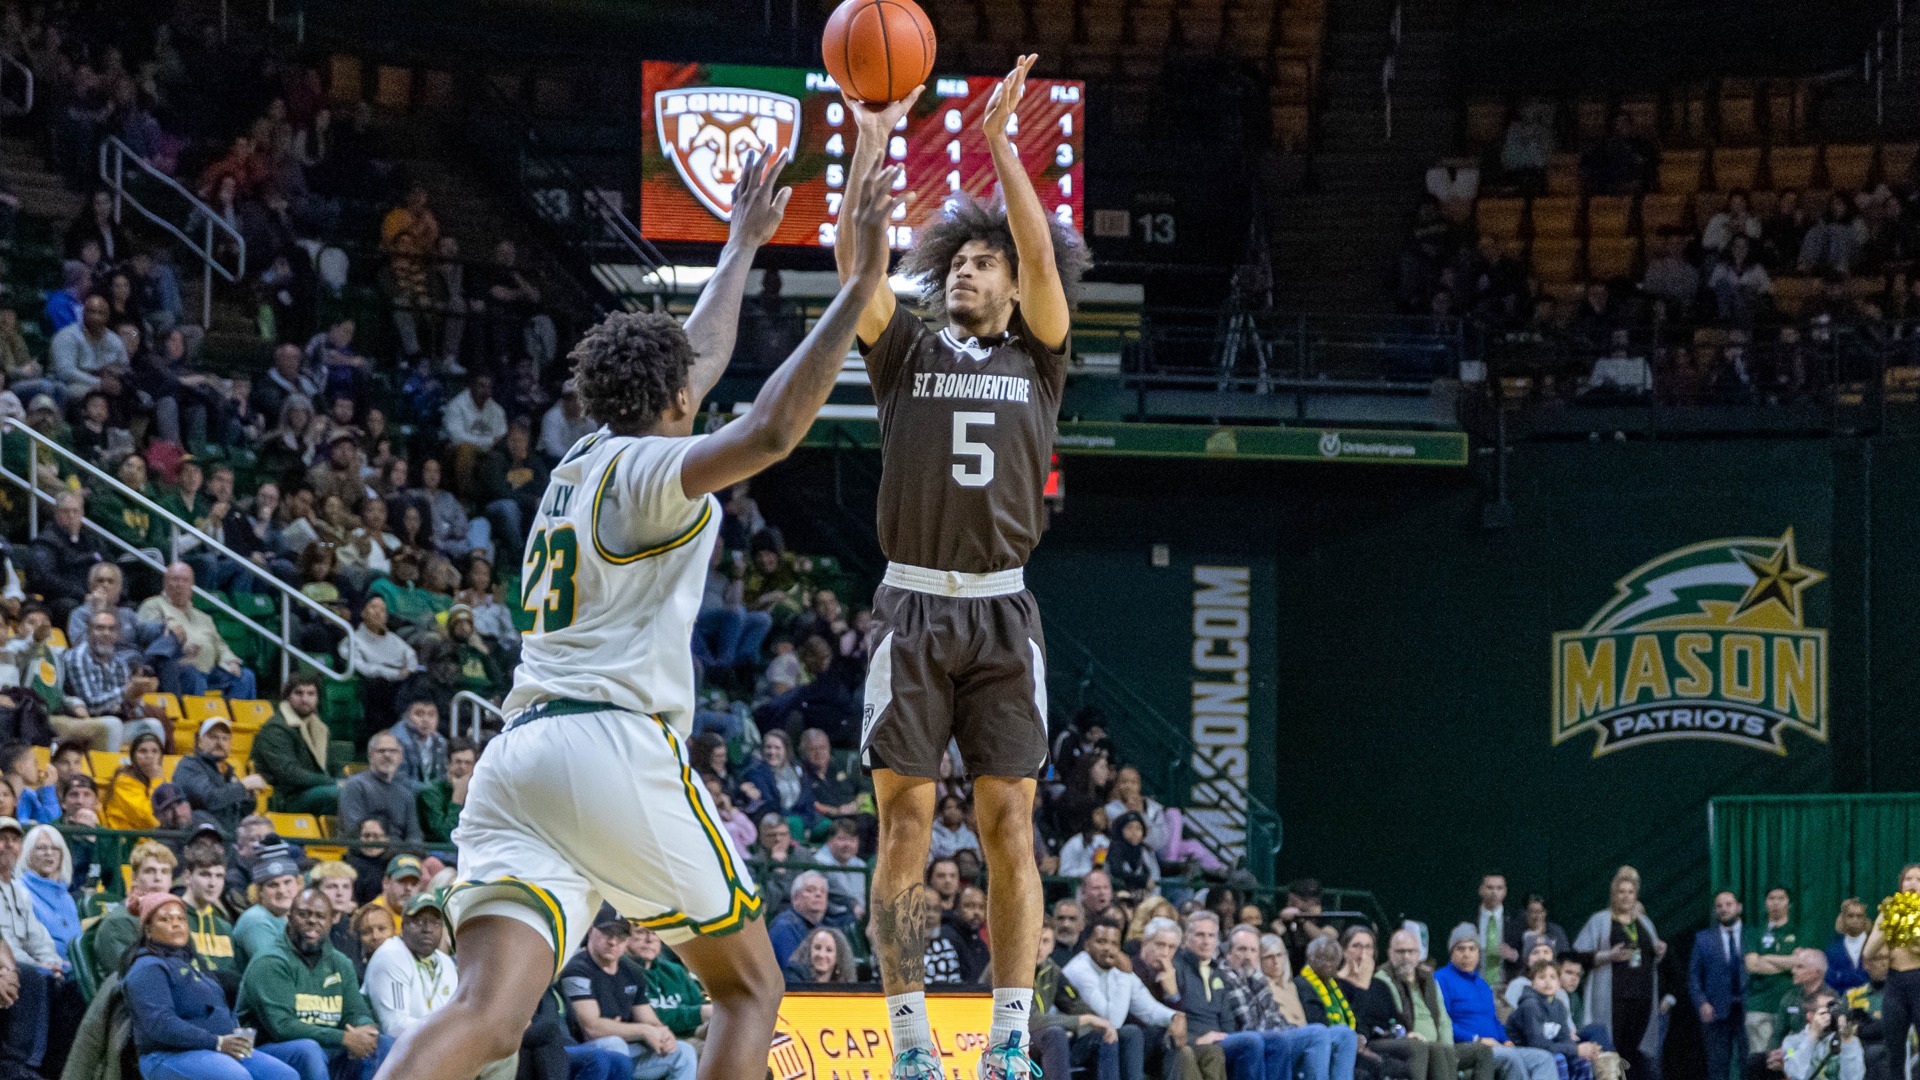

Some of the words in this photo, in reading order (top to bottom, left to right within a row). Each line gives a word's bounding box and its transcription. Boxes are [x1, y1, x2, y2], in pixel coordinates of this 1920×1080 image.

[806, 72, 841, 91] PLA
[1051, 85, 1080, 103] FLS
[663, 92, 794, 122] BONNIES
[826, 102, 845, 127] 0
[944, 109, 963, 134] 6
[1058, 113, 1073, 137] 1
[825, 132, 845, 158] 4
[946, 139, 961, 164] 1
[1055, 143, 1074, 167] 3
[826, 163, 844, 188] 5
[946, 169, 961, 191] 1
[1058, 173, 1073, 197] 1
[825, 192, 844, 216] 7
[1055, 204, 1073, 226] 2
[887, 225, 913, 249] 15
[1139, 213, 1176, 244] 13
[912, 372, 931, 398] ST.
[933, 373, 1030, 404] BONAVENTURE
[952, 411, 996, 487] 5
[522, 523, 580, 635] 23
[1563, 632, 1817, 728] MASON
[1613, 708, 1767, 738] PATRIOTS
[820, 1029, 955, 1059] CAPIL
